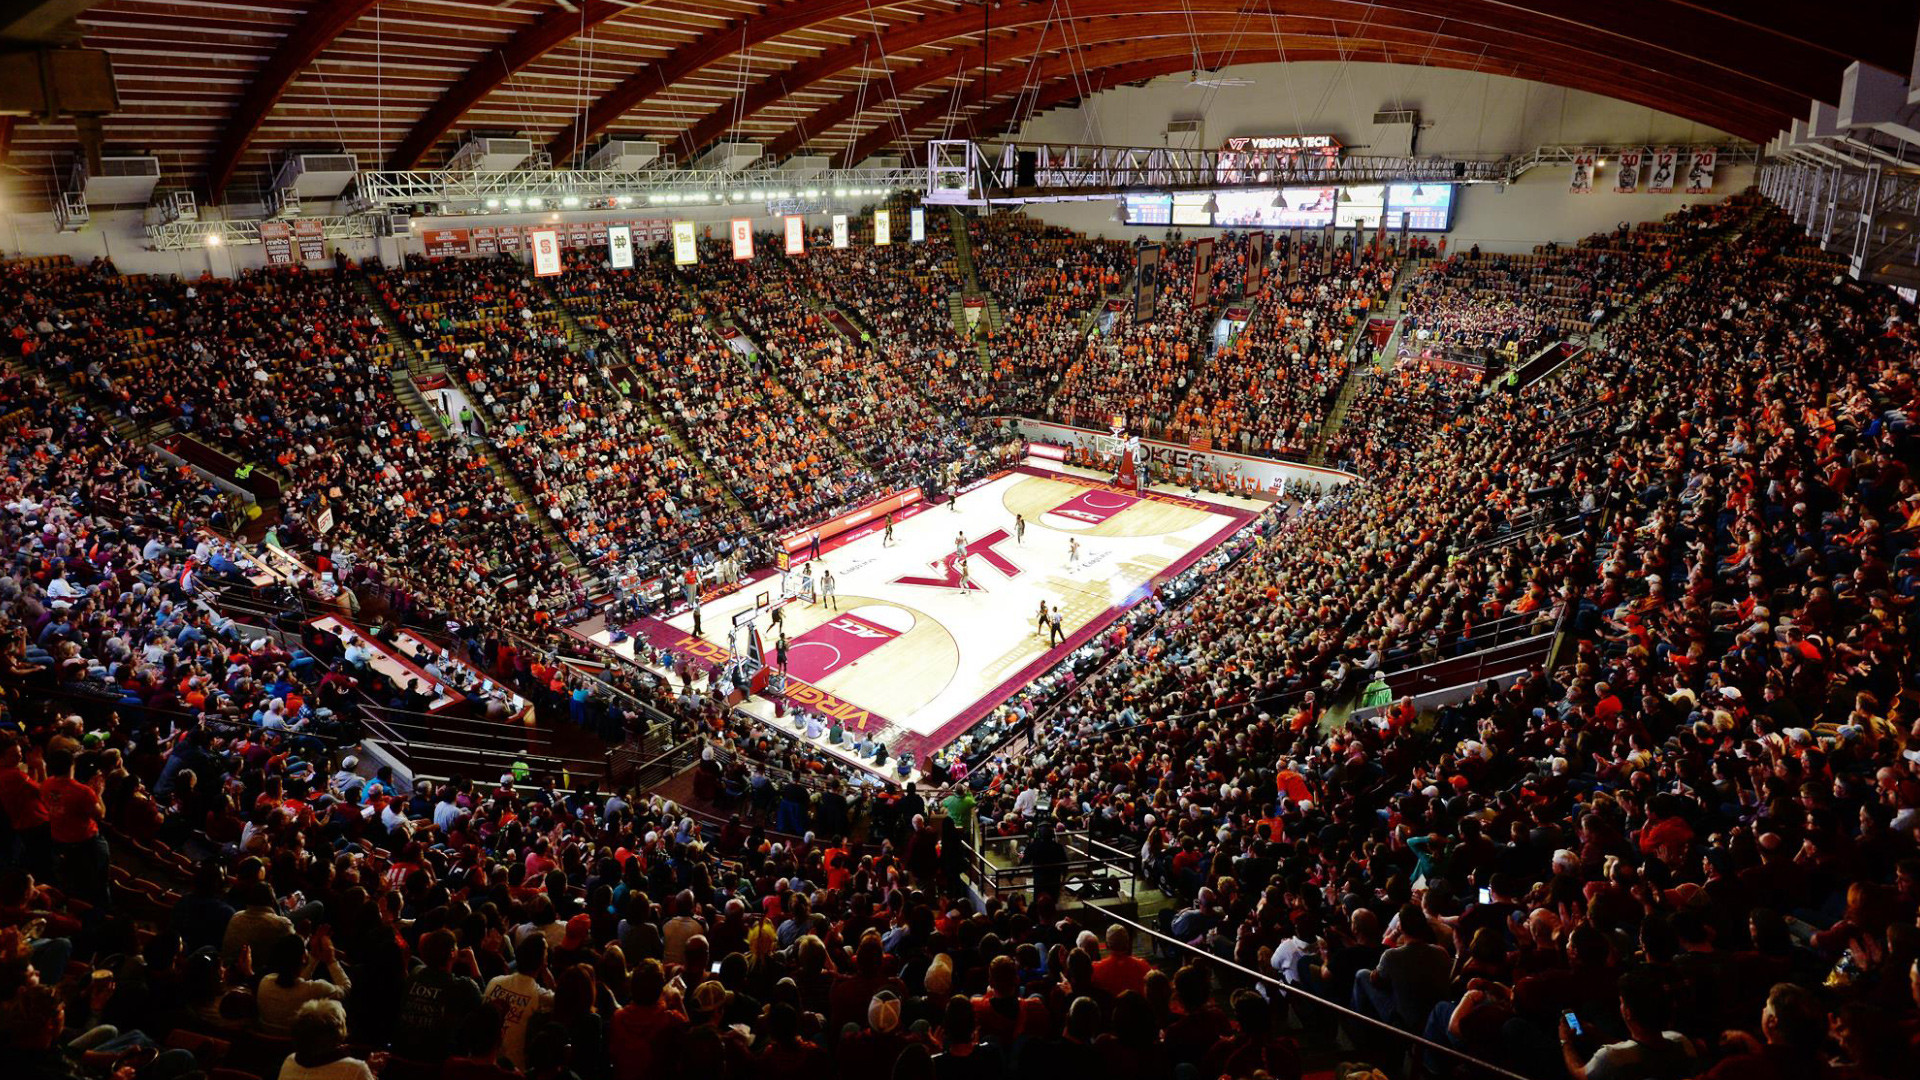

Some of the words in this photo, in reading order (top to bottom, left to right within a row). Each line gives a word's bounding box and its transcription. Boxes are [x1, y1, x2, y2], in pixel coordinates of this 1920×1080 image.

[1229, 138, 1250, 150] VT
[1251, 137, 1300, 149] VIRGINIA
[1301, 136, 1330, 147] TECH
[1574, 154, 1593, 166] 44
[1621, 154, 1638, 166] 30
[1657, 154, 1672, 166] 12
[1695, 153, 1713, 166] 20
[1145, 493, 1210, 512] TECH
[828, 618, 891, 639] ACC
[408, 981, 442, 999] LOST
